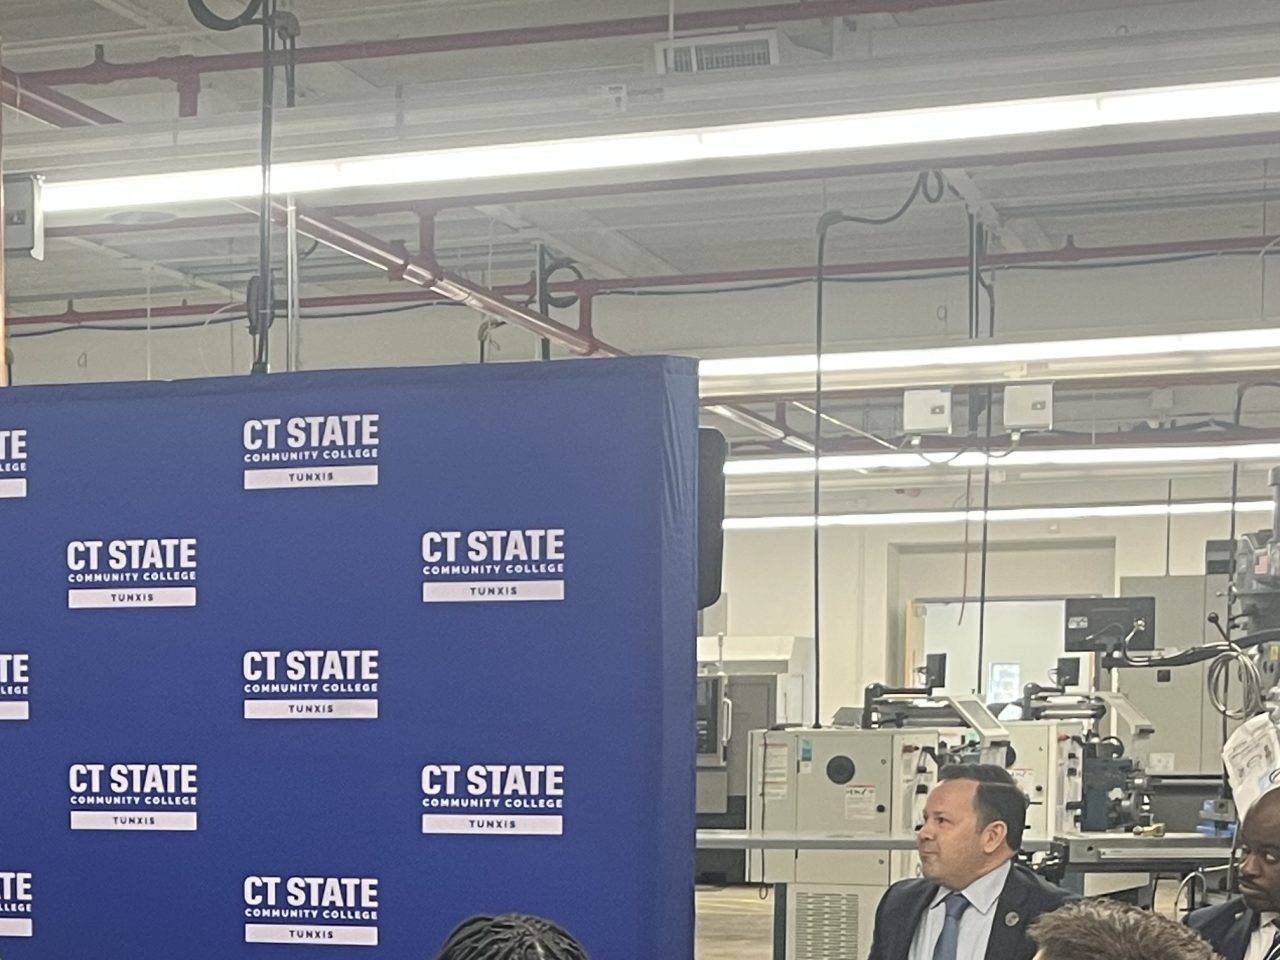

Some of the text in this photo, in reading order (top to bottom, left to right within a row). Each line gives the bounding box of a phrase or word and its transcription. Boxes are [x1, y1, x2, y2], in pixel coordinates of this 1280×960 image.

[243, 414, 380, 451] CT STATE
[243, 448, 378, 463] COMMUNITY COLLEGE
[288, 471, 334, 483] TUNXIS
[421, 528, 565, 563] CT STATE
[67, 538, 197, 571] CT STATE
[422, 563, 564, 575] COMMUNITY COLLEGE
[67, 570, 196, 583] COMMUNITY COLLEGE
[469, 586, 518, 597] TUNXIS
[110, 593, 154, 603] TUNXIS
[243, 649, 379, 681] CT STATE
[243, 682, 378, 693] COMMUNITY COLLEGE
[288, 704, 334, 714] TUNXIS
[69, 764, 198, 794] CT STATE
[421, 764, 565, 796] CT STATE
[70, 795, 197, 806] COMMUNITY COLLEGE
[422, 798, 563, 809] COMMUNITY COLLEGE
[112, 816, 156, 825] TUNXIS
[468, 819, 517, 829] TUNXIS
[244, 875, 379, 908] CT STATE
[244, 908, 378, 920] COMMUNITY COLLEGE
[288, 929, 334, 940] TUNXIS
